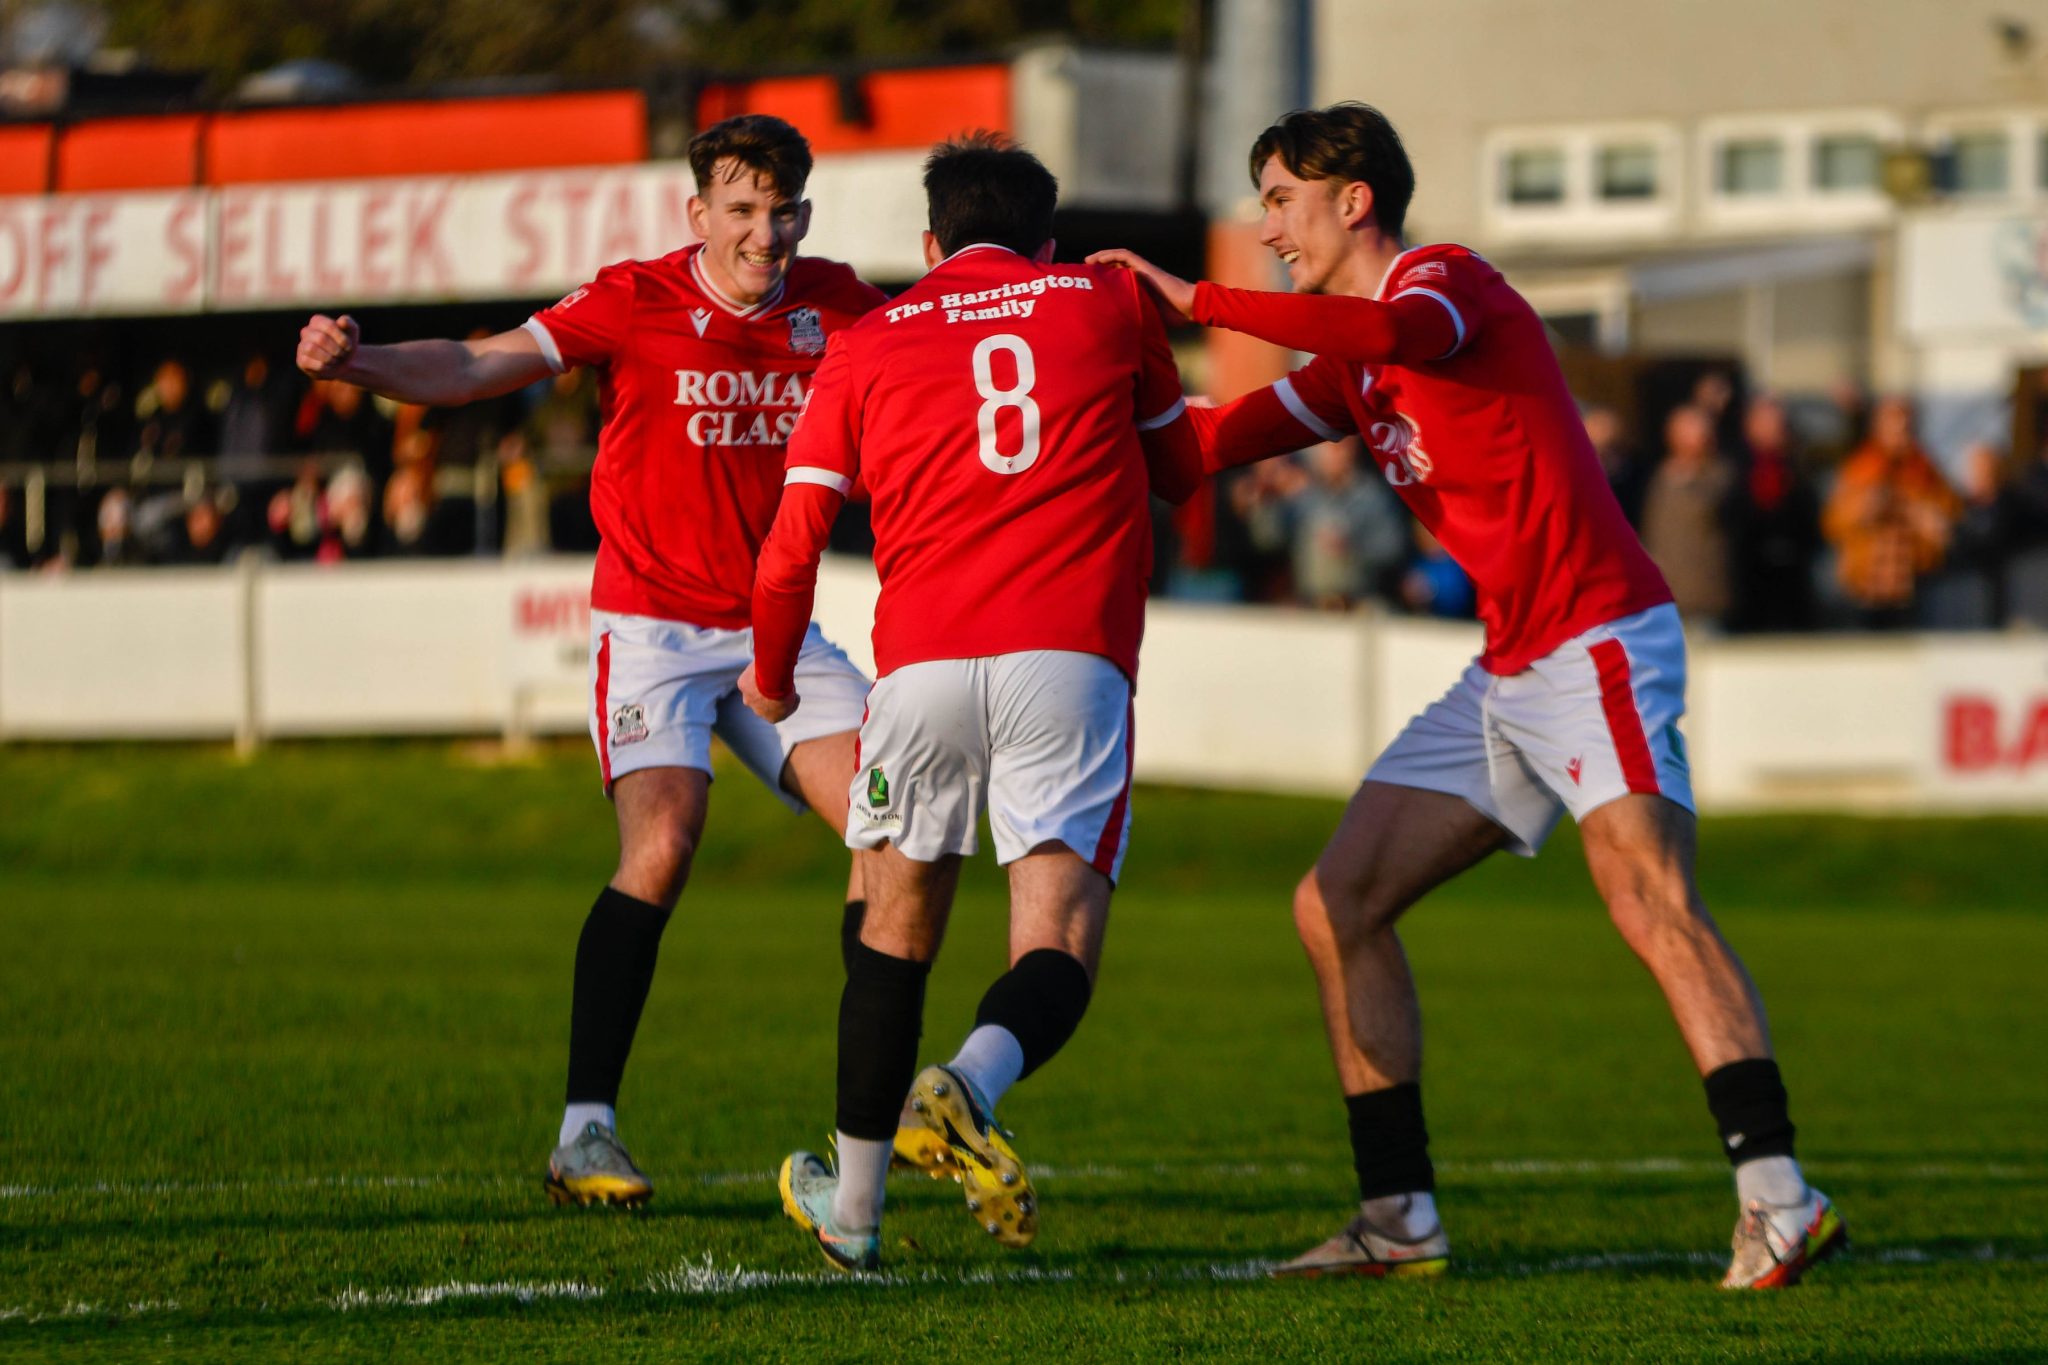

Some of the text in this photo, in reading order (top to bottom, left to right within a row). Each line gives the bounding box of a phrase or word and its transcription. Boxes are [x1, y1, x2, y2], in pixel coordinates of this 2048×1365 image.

[161, 180, 456, 305] SELLEK
[886, 274, 1093, 323] The Harrington
[946, 299, 1036, 324] Family
[673, 369, 813, 407] ROMA
[972, 333, 1041, 475] 8
